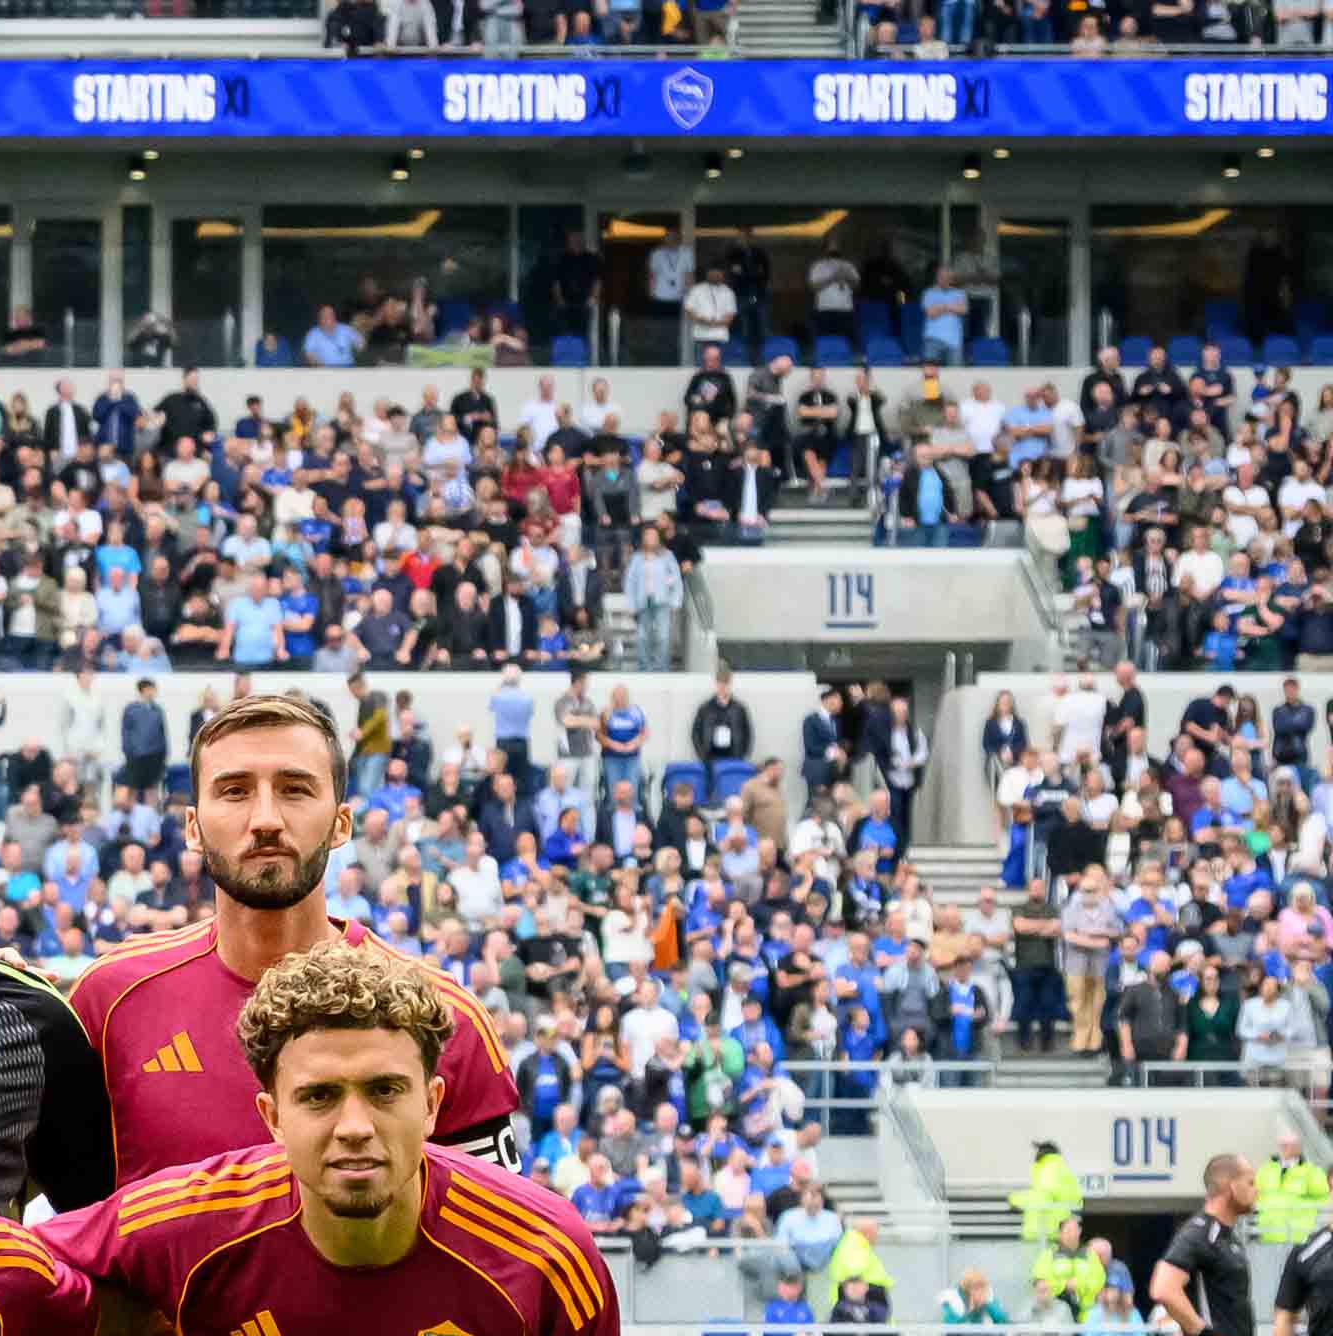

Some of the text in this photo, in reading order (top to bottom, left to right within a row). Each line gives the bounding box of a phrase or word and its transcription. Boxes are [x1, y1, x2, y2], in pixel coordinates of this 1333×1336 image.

[72, 73, 216, 122] STARTING
[443, 73, 586, 122] STARTING
[813, 73, 957, 122] STARTING
[1184, 73, 1328, 122] STARTING
[827, 572, 875, 616] 114
[1112, 1117, 1177, 1167] 014
